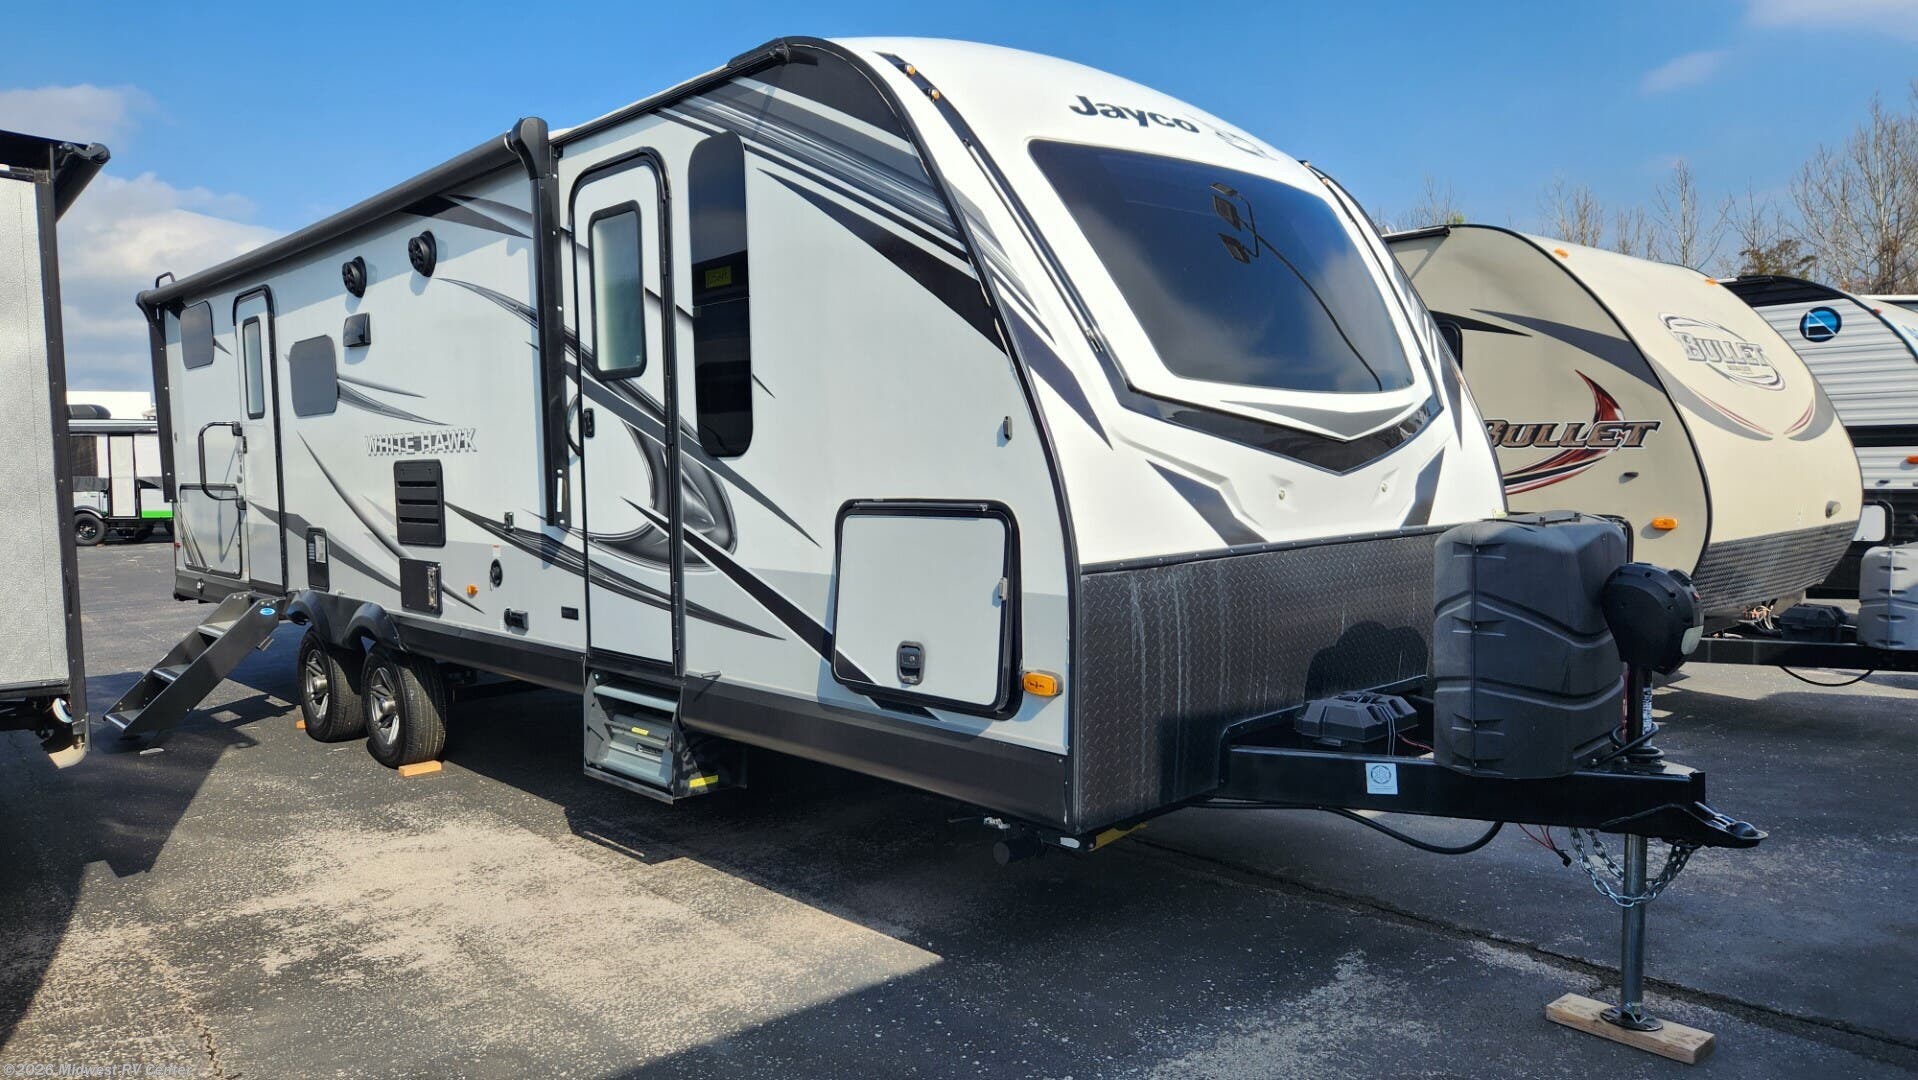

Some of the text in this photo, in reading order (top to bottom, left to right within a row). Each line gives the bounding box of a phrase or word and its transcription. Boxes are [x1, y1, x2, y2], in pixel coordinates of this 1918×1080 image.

[1068, 94, 1200, 134] Jayco
[1673, 331, 1771, 367] BULLET
[364, 427, 478, 457] WHITE HAWK
